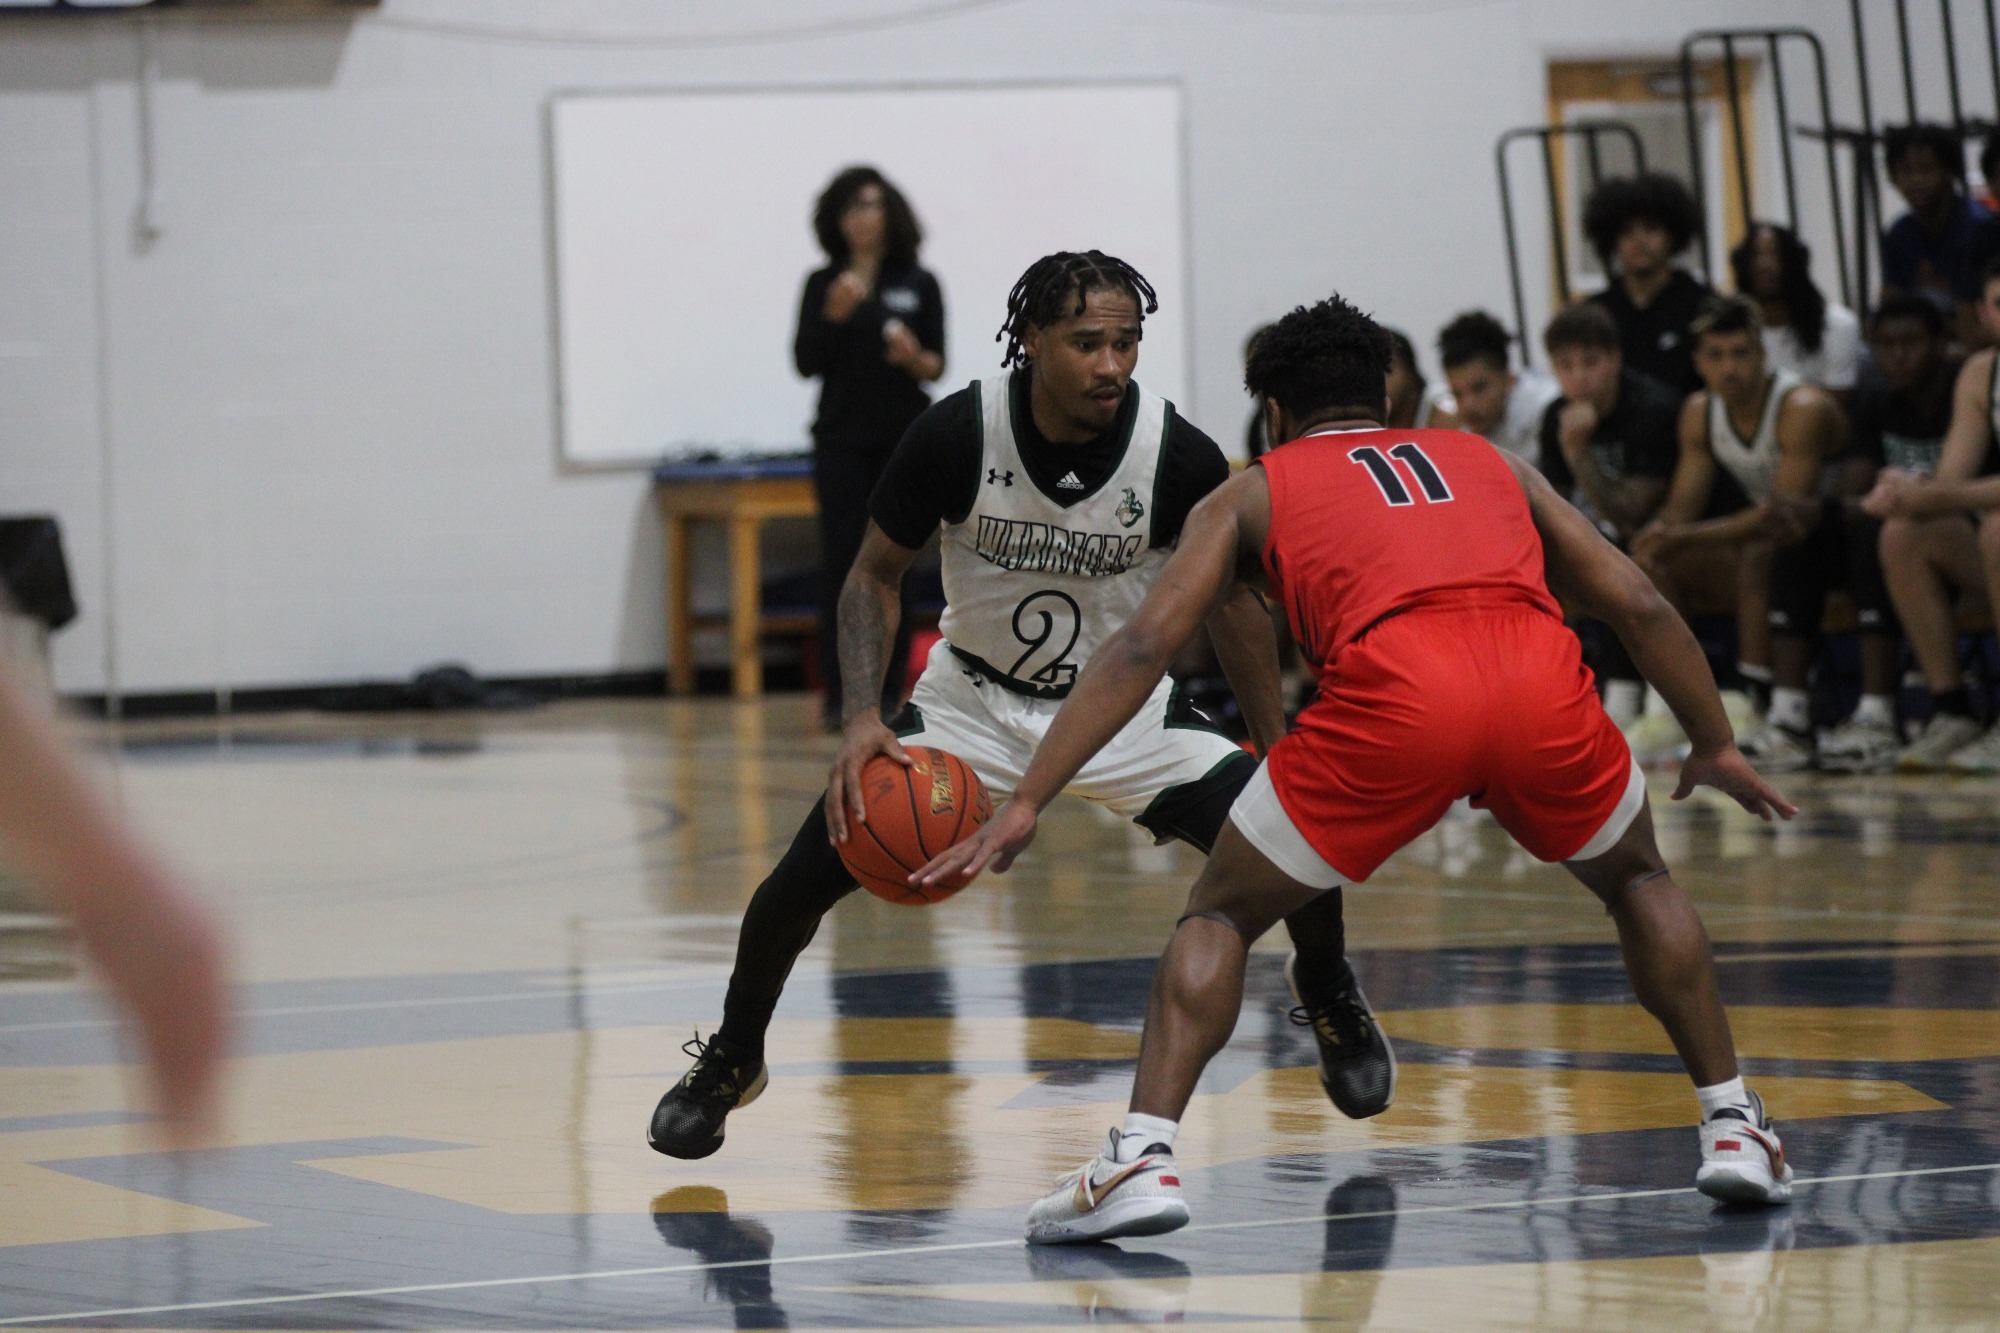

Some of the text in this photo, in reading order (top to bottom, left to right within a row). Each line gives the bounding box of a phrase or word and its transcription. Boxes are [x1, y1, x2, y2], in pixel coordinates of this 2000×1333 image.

[1056, 480, 1085, 490] adidas
[1346, 442, 1455, 507] 11
[976, 514, 1142, 577] WARRIORS
[1009, 590, 1081, 687] 2
